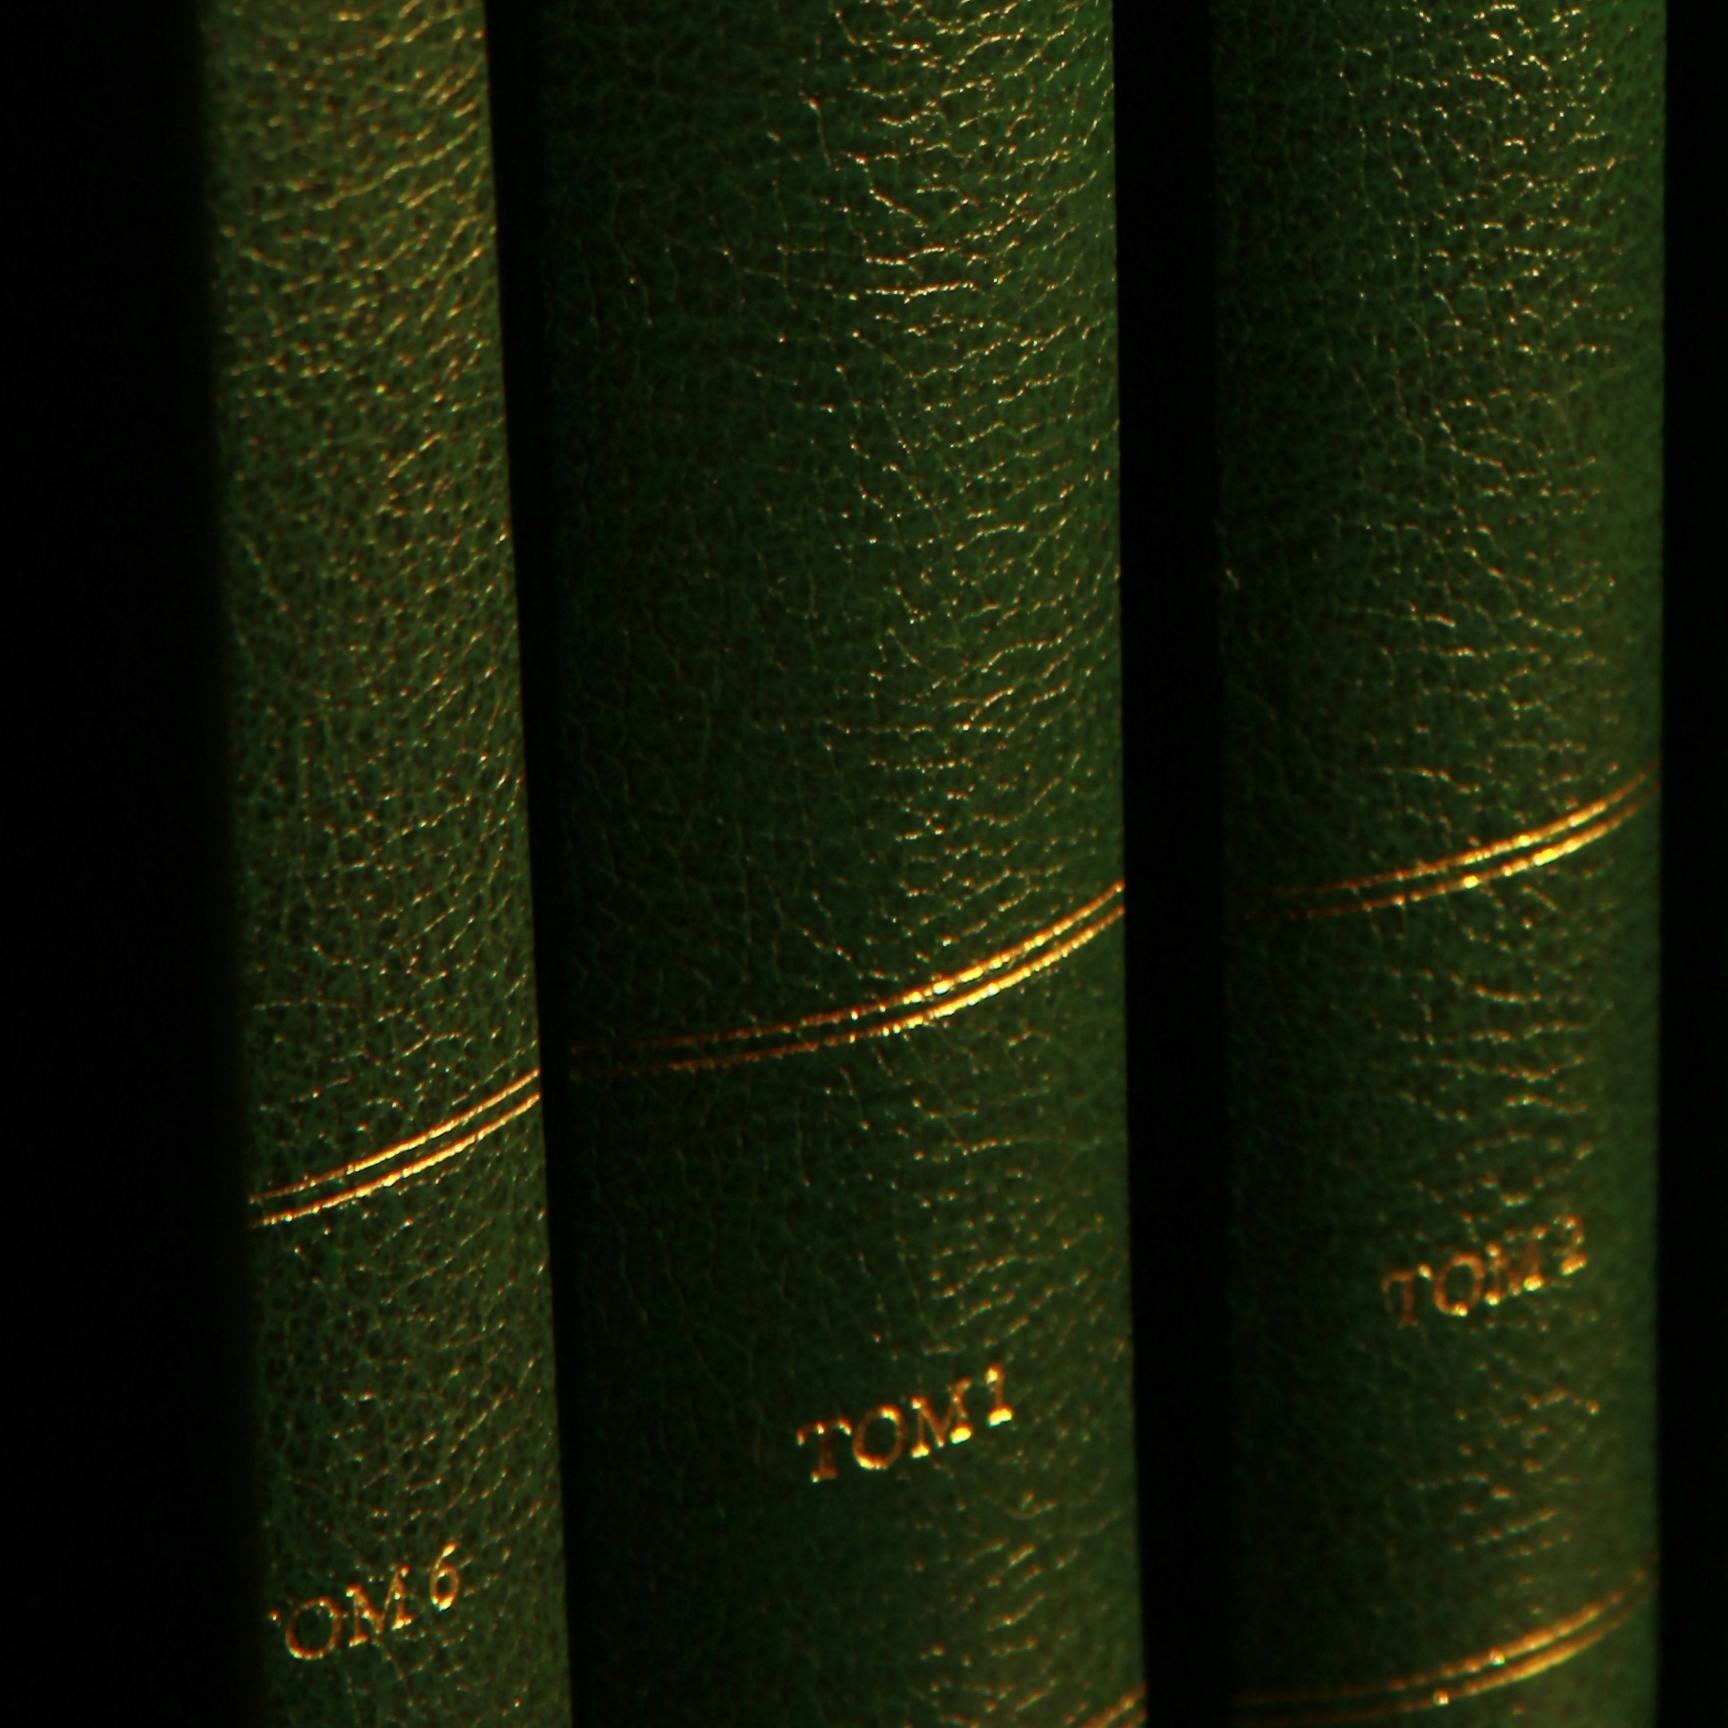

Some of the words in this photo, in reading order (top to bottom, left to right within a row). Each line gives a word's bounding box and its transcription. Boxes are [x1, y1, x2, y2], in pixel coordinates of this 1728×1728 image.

[795, 1374, 974, 1484] ТОМ
[263, 1562, 416, 1661] ОМ
[430, 1539, 462, 1612] 6
